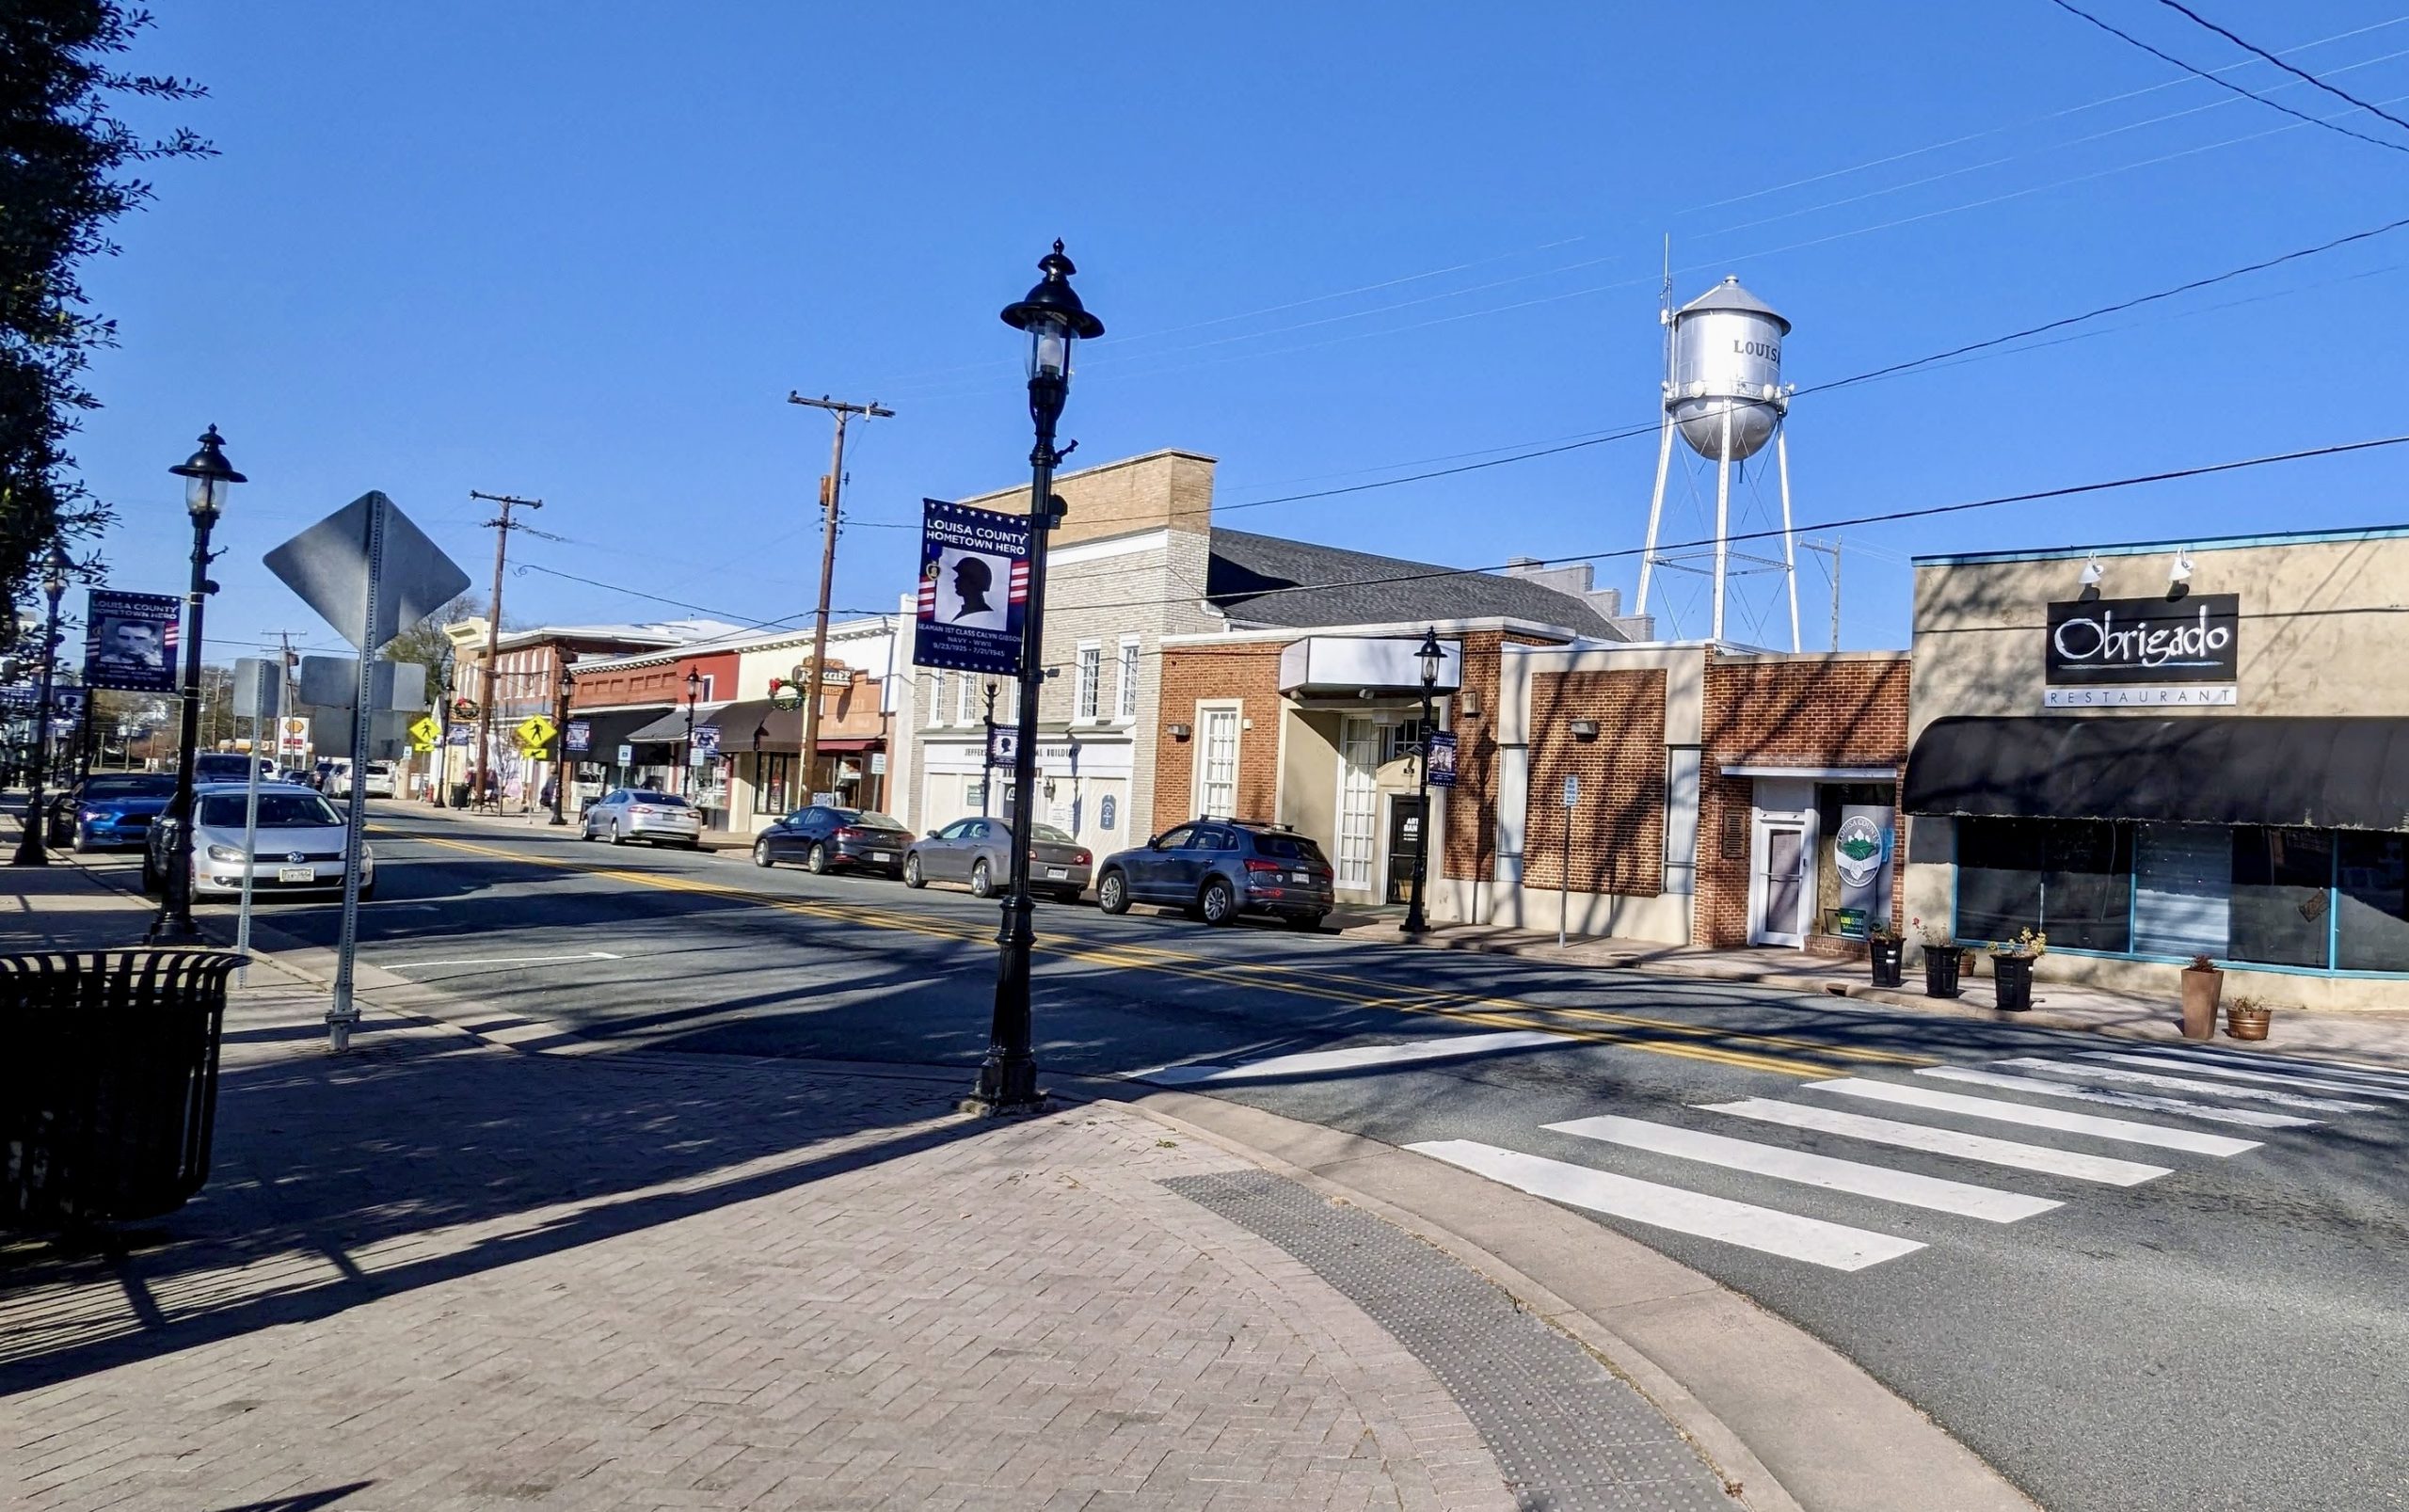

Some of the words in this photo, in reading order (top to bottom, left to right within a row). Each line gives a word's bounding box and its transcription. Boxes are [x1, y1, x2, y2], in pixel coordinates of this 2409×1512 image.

[927, 518, 973, 535] LOUISA
[976, 528, 1027, 545] COUNTY
[926, 530, 993, 550] HOMETOWN
[996, 543, 1026, 555] HERO
[134, 603, 179, 613] COUNTY
[917, 623, 944, 633] SEAMAN
[955, 628, 976, 637] CLASS
[2054, 604, 2229, 667] Obrigado
[948, 636, 967, 645] NAVY
[2050, 690, 2230, 704] RESTAURANT
[1838, 820, 1858, 843] LOUISA
[1859, 819, 1880, 843] COUNTY
